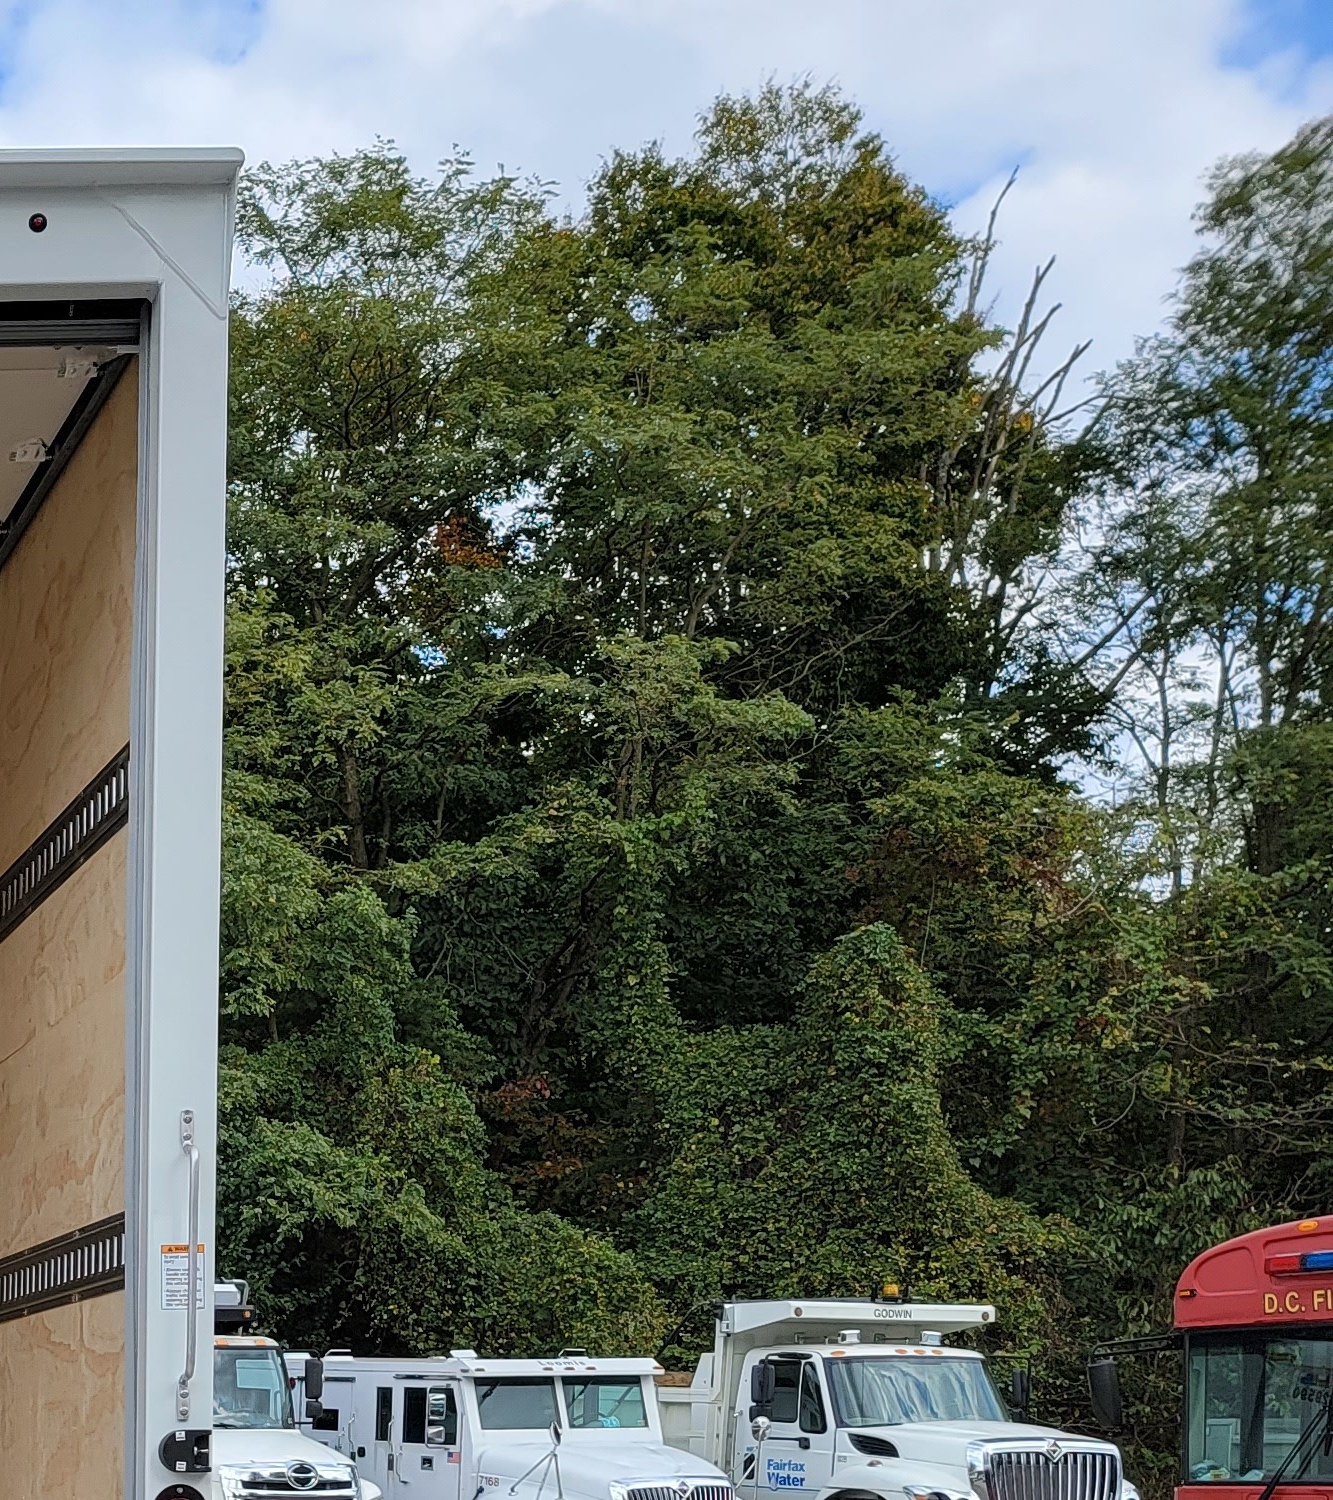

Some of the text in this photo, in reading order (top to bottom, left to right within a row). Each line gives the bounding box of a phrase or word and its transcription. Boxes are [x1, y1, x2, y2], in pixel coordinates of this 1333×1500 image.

[1264, 1291, 1306, 1314] D.C.
[873, 1308, 913, 1319] GODWIN
[767, 1458, 806, 1472] Fairfax
[478, 1475, 501, 1487] 7168
[767, 1472, 806, 1487] Water
